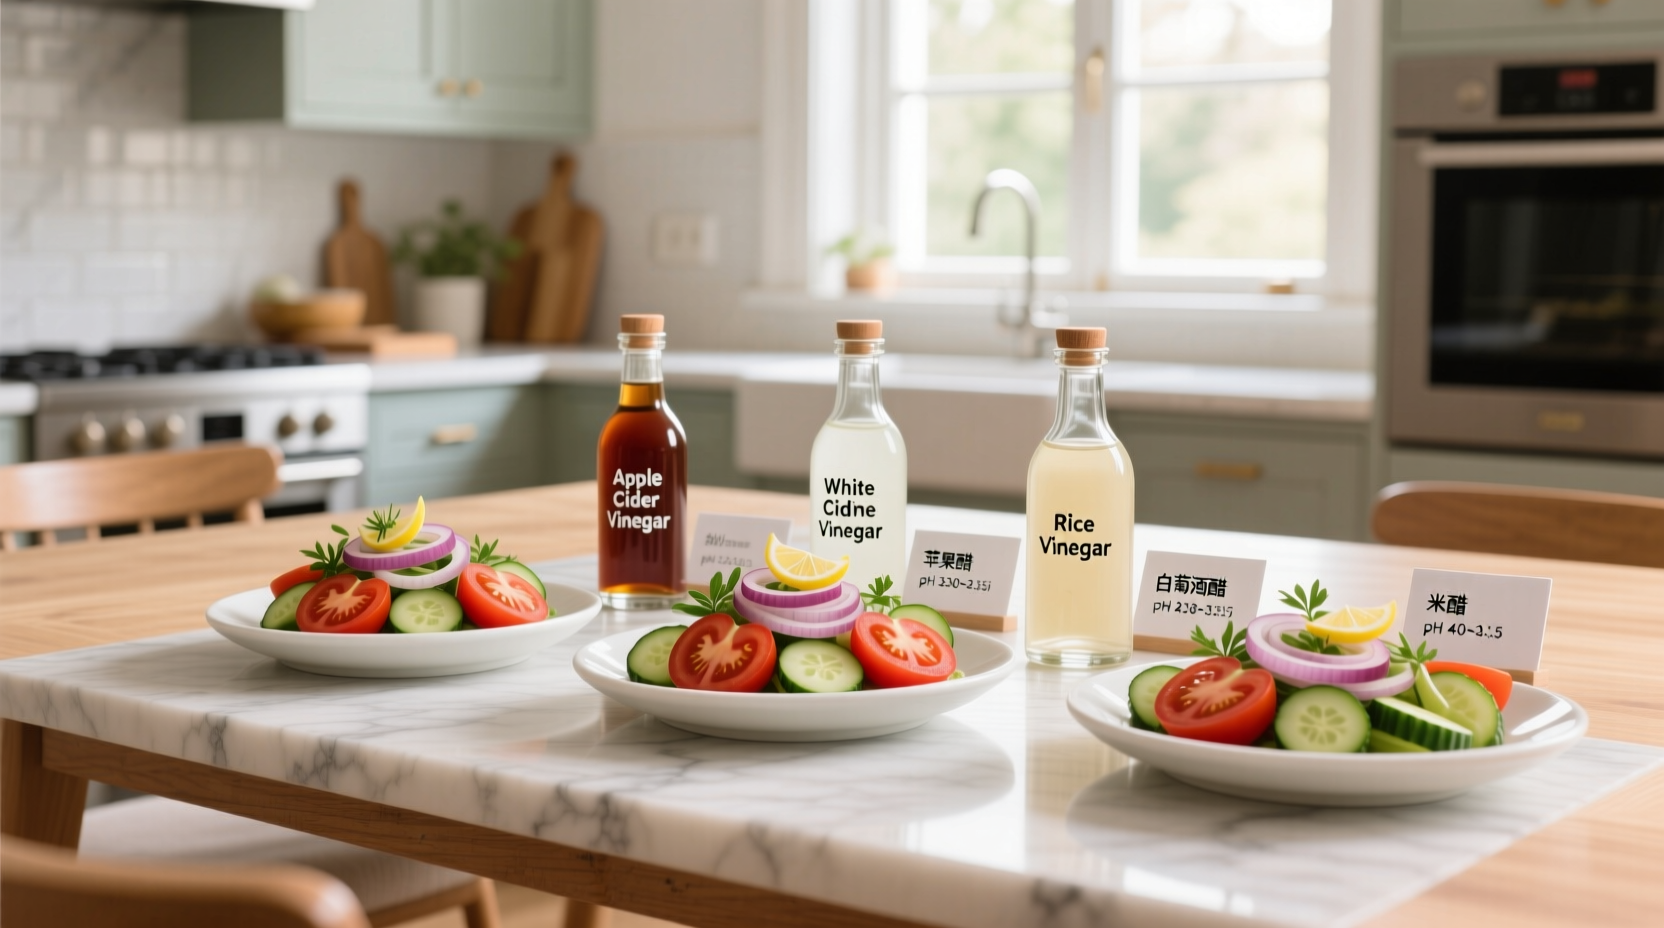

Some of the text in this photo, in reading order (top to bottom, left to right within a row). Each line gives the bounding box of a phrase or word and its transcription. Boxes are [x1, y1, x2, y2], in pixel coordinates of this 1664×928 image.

[612, 467, 663, 490] Apple
[824, 477, 875, 496] White
[612, 489, 660, 508] Cider
[606, 510, 671, 534] Vinegar
[818, 519, 883, 544] Vinegar
[1054, 513, 1095, 532] Rice
[1039, 535, 1112, 561] Vinegar
[919, 575, 936, 588] pH
[1152, 600, 1172, 614] pH
[1426, 593, 1468, 616] 米醋
[1423, 621, 1443, 636] pH
